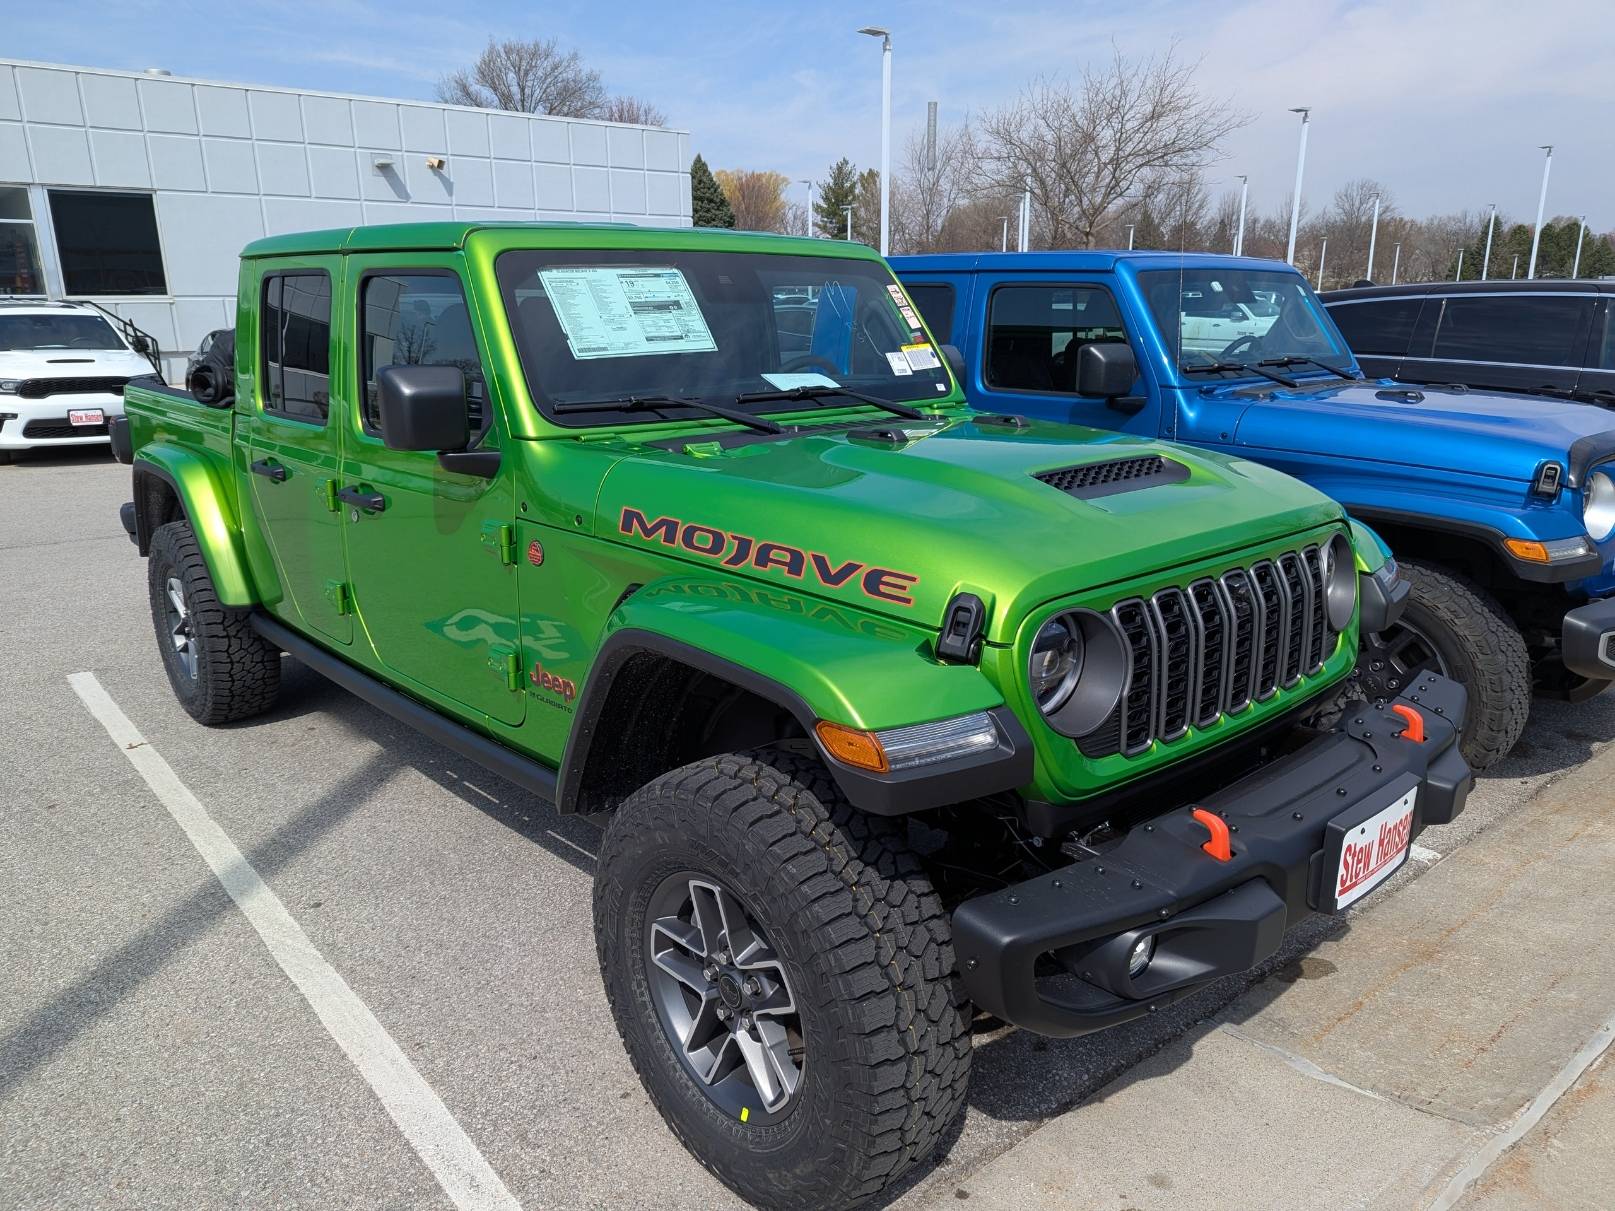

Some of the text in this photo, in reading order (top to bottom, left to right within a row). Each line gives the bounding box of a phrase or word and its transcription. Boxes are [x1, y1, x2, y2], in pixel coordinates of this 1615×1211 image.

[619, 506, 920, 607] MOJAVE
[529, 661, 577, 704] Jeep
[1340, 840, 1374, 888] Stew
[1376, 810, 1413, 864] Hansen
